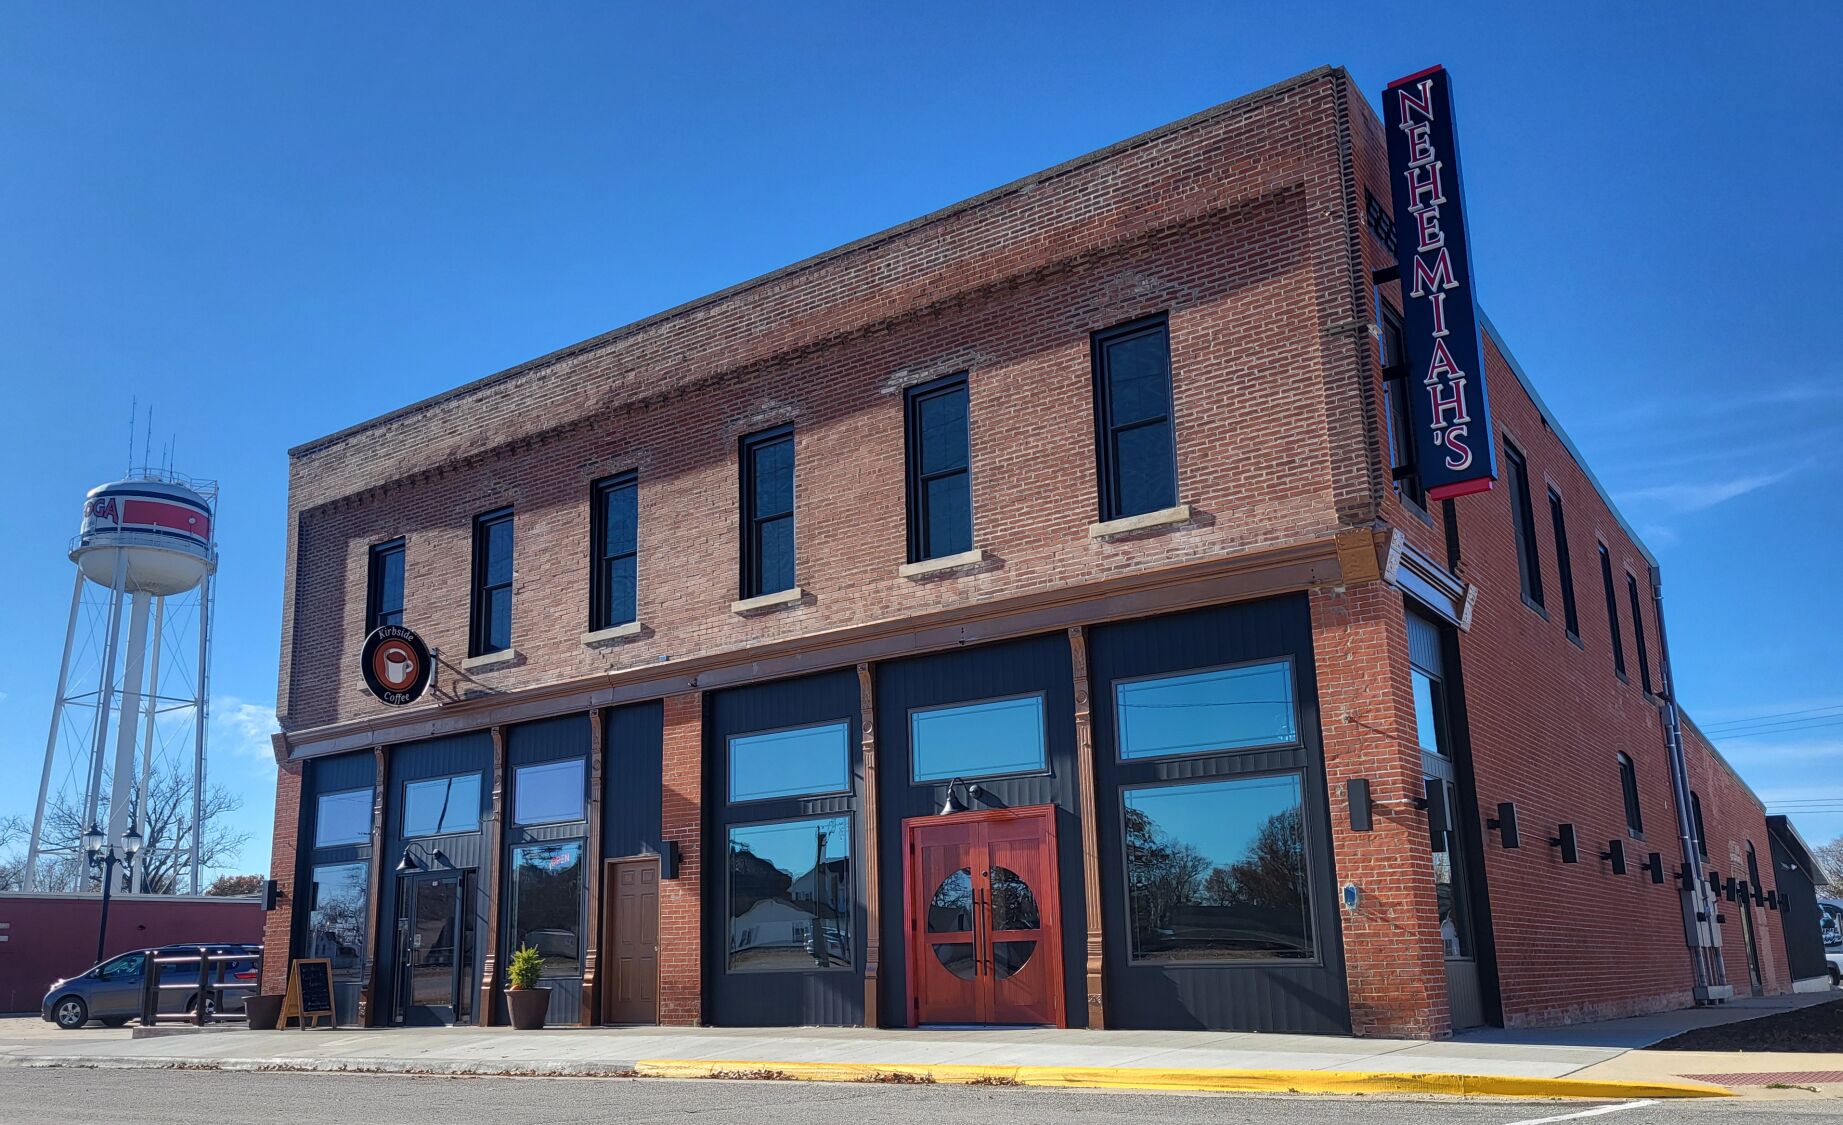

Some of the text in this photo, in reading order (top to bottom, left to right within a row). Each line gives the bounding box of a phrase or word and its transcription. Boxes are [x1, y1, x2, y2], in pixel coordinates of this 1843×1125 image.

[1397, 78, 1473, 471] NEHEMIAH'S
[378, 626, 414, 642] Kirbside
[384, 691, 410, 705] Coffee
